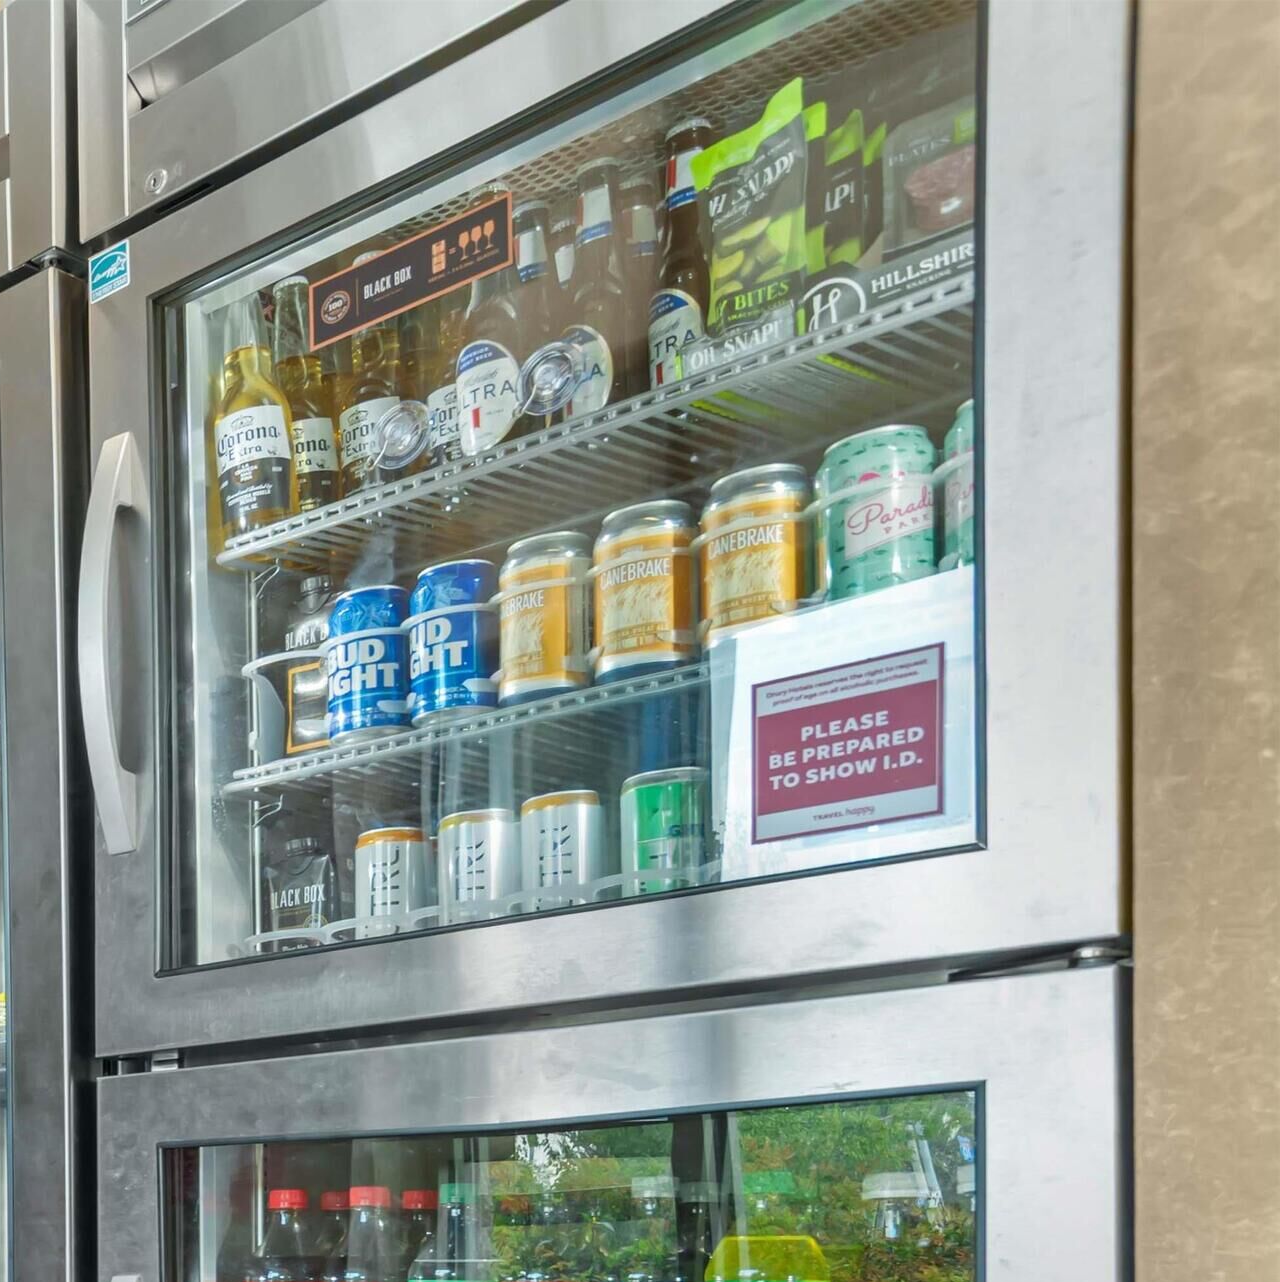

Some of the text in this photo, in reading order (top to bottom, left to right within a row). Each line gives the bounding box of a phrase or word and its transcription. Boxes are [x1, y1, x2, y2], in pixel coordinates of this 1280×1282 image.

[364, 273, 392, 299] BLACK
[394, 266, 413, 288] BOX
[871, 243, 974, 295] HILLSHIR
[735, 281, 789, 310] BITES
[723, 319, 781, 363] SNAP!
[462, 380, 514, 408] LTRA
[217, 425, 280, 457] Corona
[295, 438, 329, 454] ona
[708, 523, 784, 560] CANEBRAKE
[600, 557, 669, 591] CANEBRAKE
[801, 711, 889, 741] PLEASE
[769, 727, 925, 770] BE PREPARED
[769, 751, 923, 790] TO SHOW I.D.
[303, 882, 325, 903] BOX
